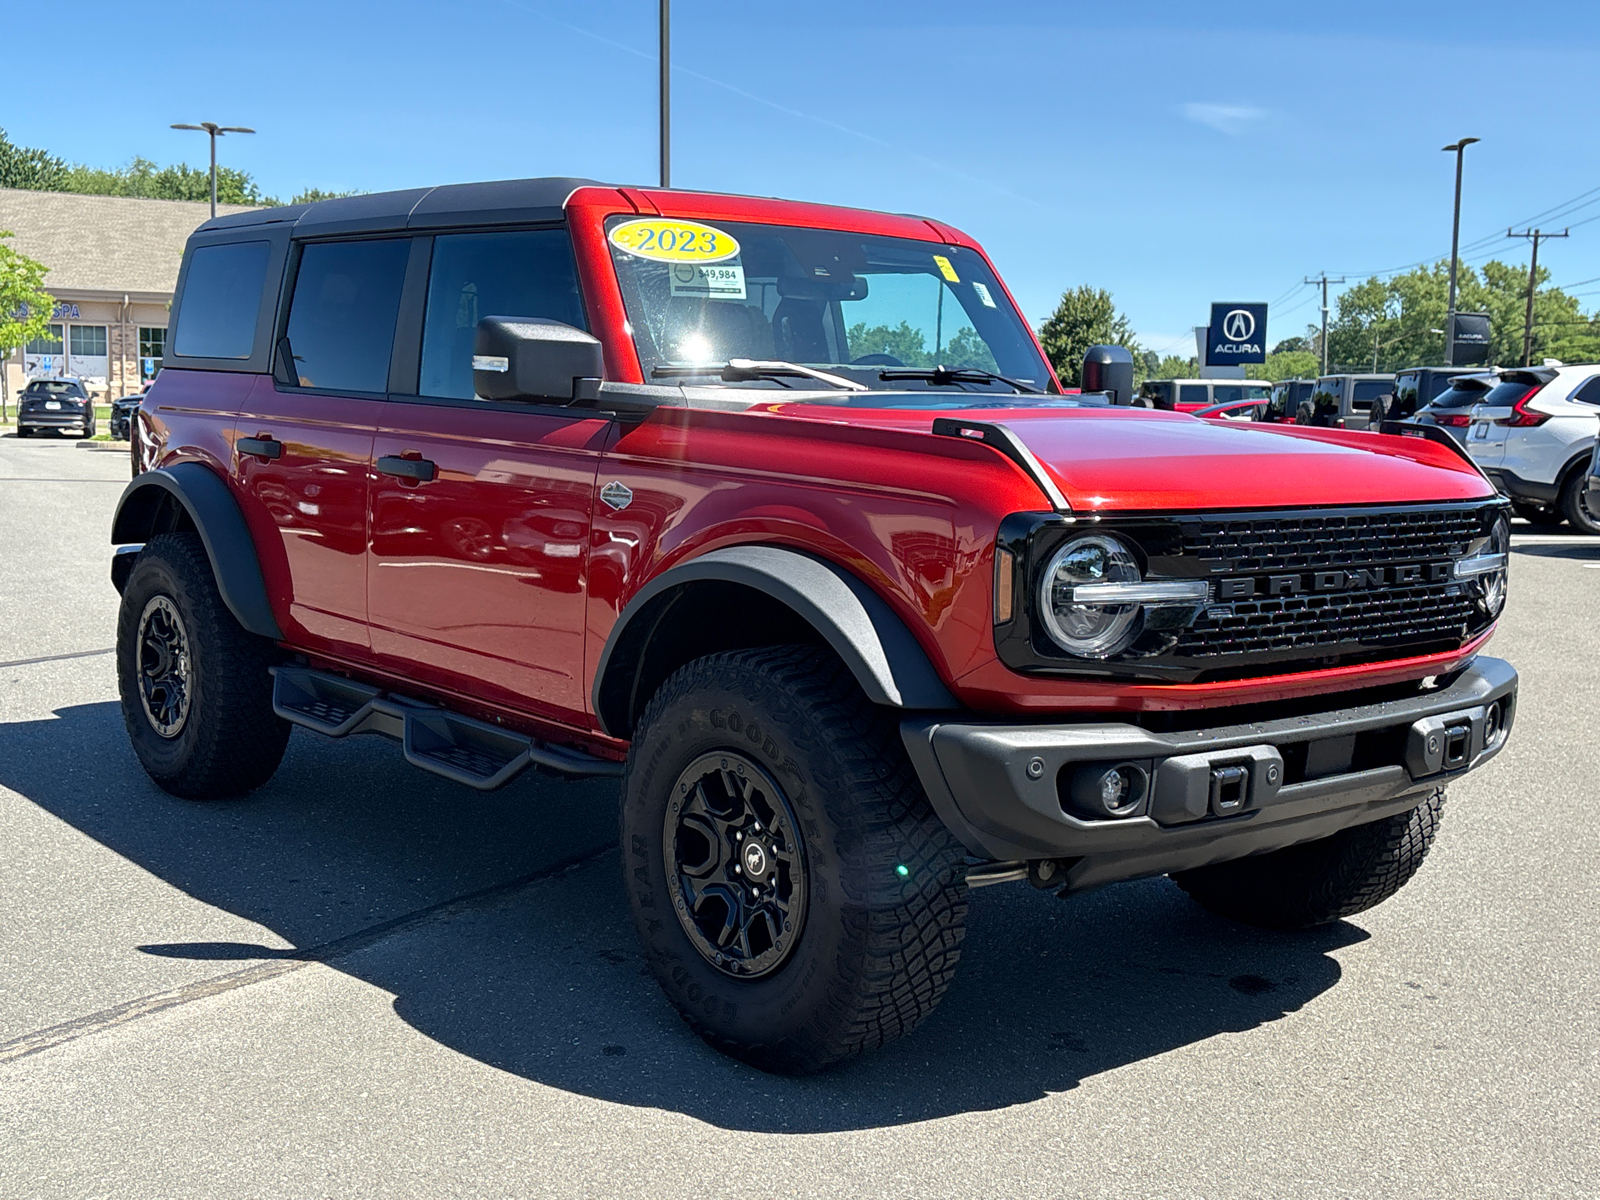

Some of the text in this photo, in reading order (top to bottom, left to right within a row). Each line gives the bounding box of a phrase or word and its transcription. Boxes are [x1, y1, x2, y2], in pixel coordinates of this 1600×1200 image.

[637, 228, 717, 253] 2023
[698, 269, 737, 281] $49,984
[52, 303, 81, 319] SPA
[1215, 344, 1261, 353] ACURA
[1219, 561, 1455, 599] BRONCO
[709, 706, 830, 905] GOODYEAR
